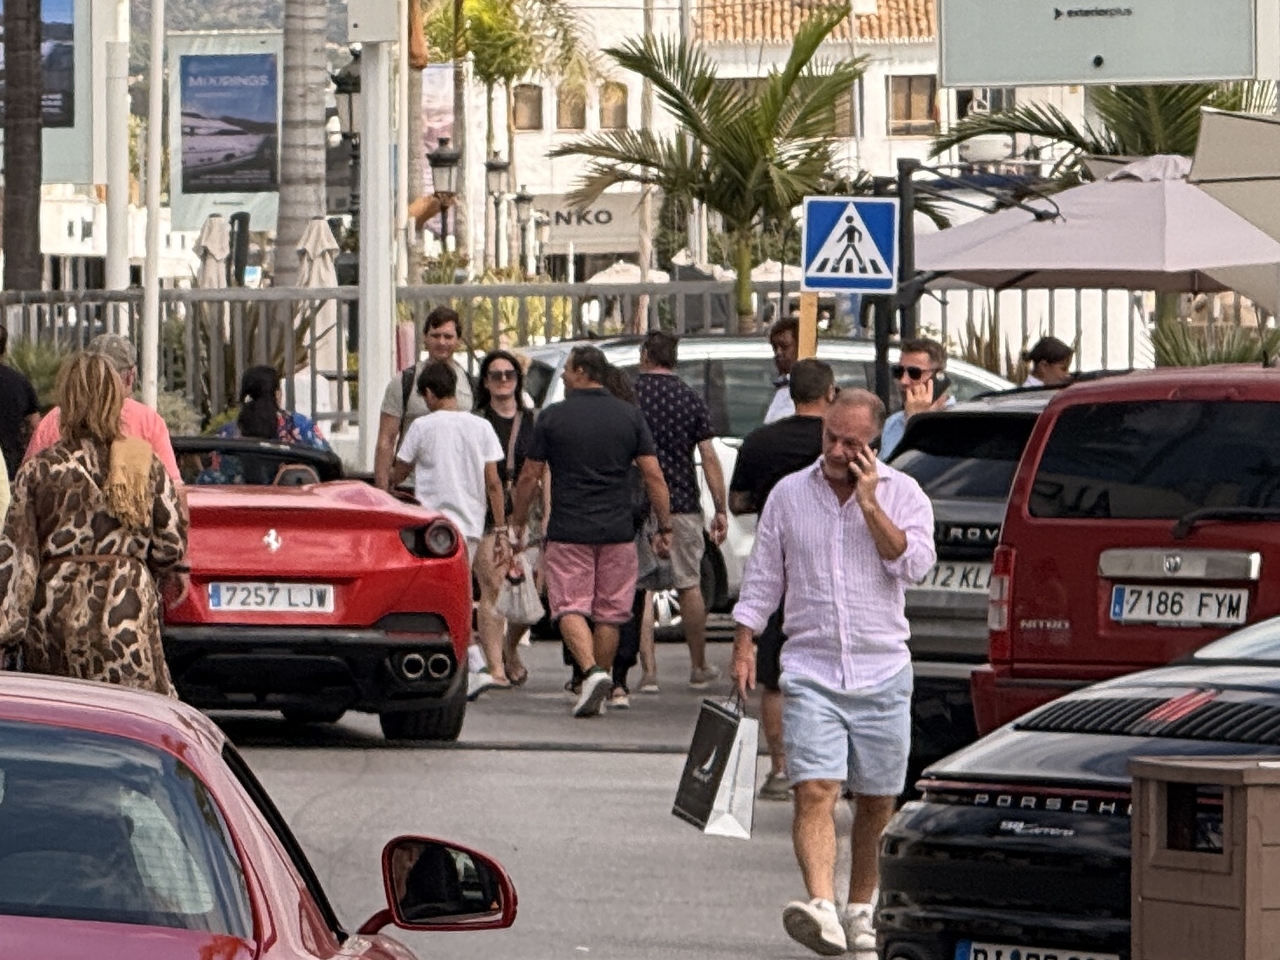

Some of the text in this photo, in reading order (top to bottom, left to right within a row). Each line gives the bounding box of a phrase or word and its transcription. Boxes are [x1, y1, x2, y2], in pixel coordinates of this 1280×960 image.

[548, 209, 613, 226] NKO
[917, 564, 992, 589] 12 KL
[225, 585, 328, 608] 7257 LJW
[1128, 589, 1242, 619] 7186 FYM
